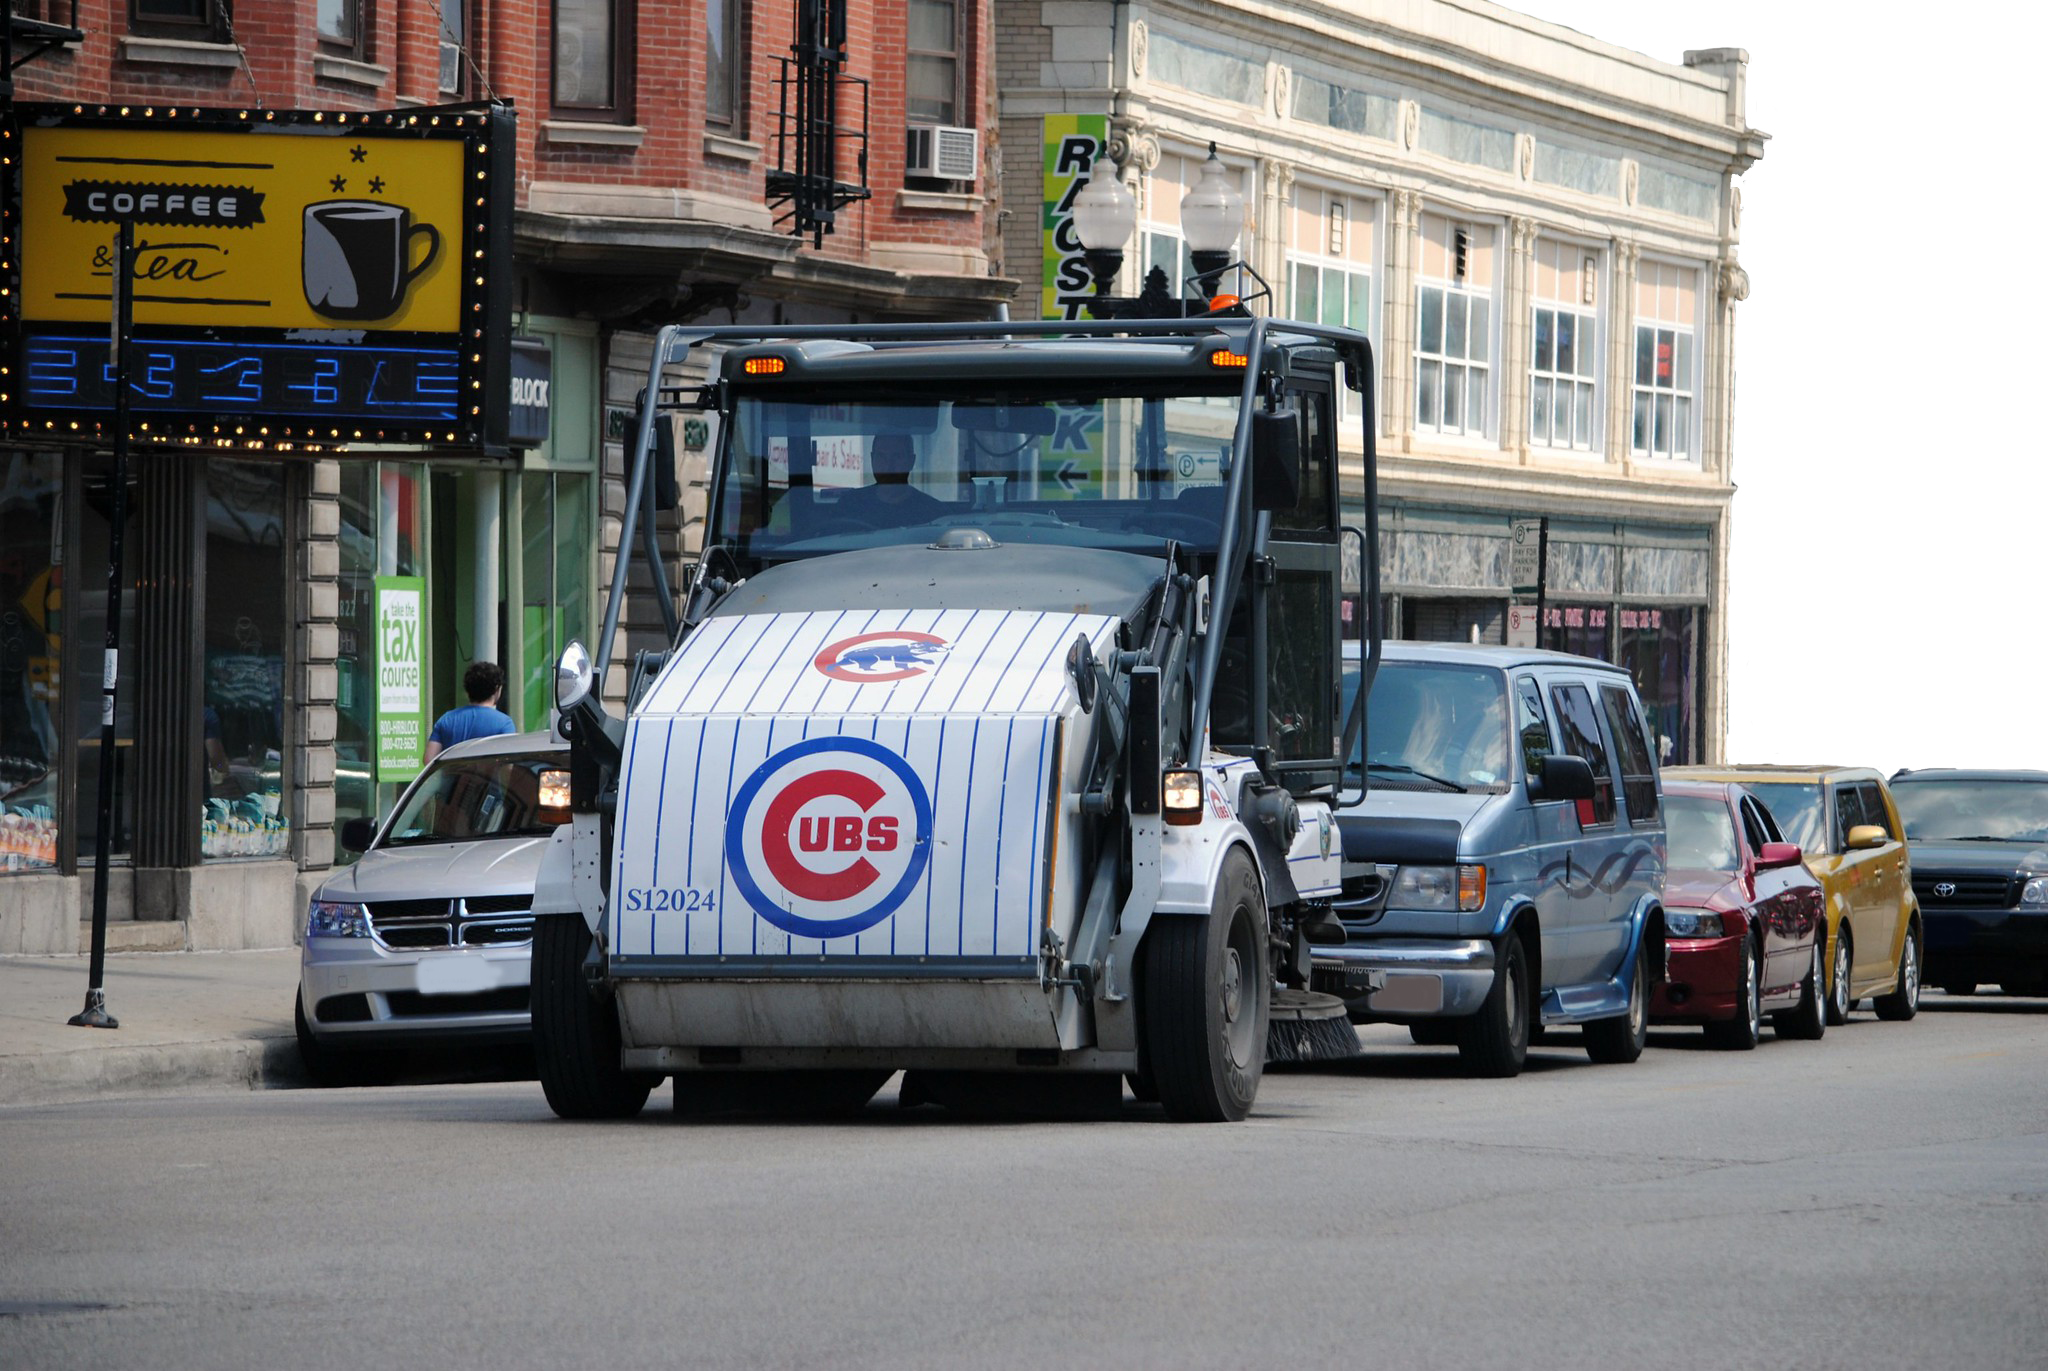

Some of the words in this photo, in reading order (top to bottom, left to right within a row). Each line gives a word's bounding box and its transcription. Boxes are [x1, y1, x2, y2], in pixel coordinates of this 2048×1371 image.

[87, 191, 238, 218] COFFEE
[91, 244, 113, 269] &
[132, 239, 227, 282] tea
[1052, 138, 1097, 450] RGSTK
[511, 376, 549, 408] BLOCK
[841, 439, 861, 470] Sales
[391, 602, 404, 616] take
[405, 602, 415, 616] the
[382, 609, 417, 663] tax
[382, 666, 418, 688] course
[626, 888, 716, 912] S12024
